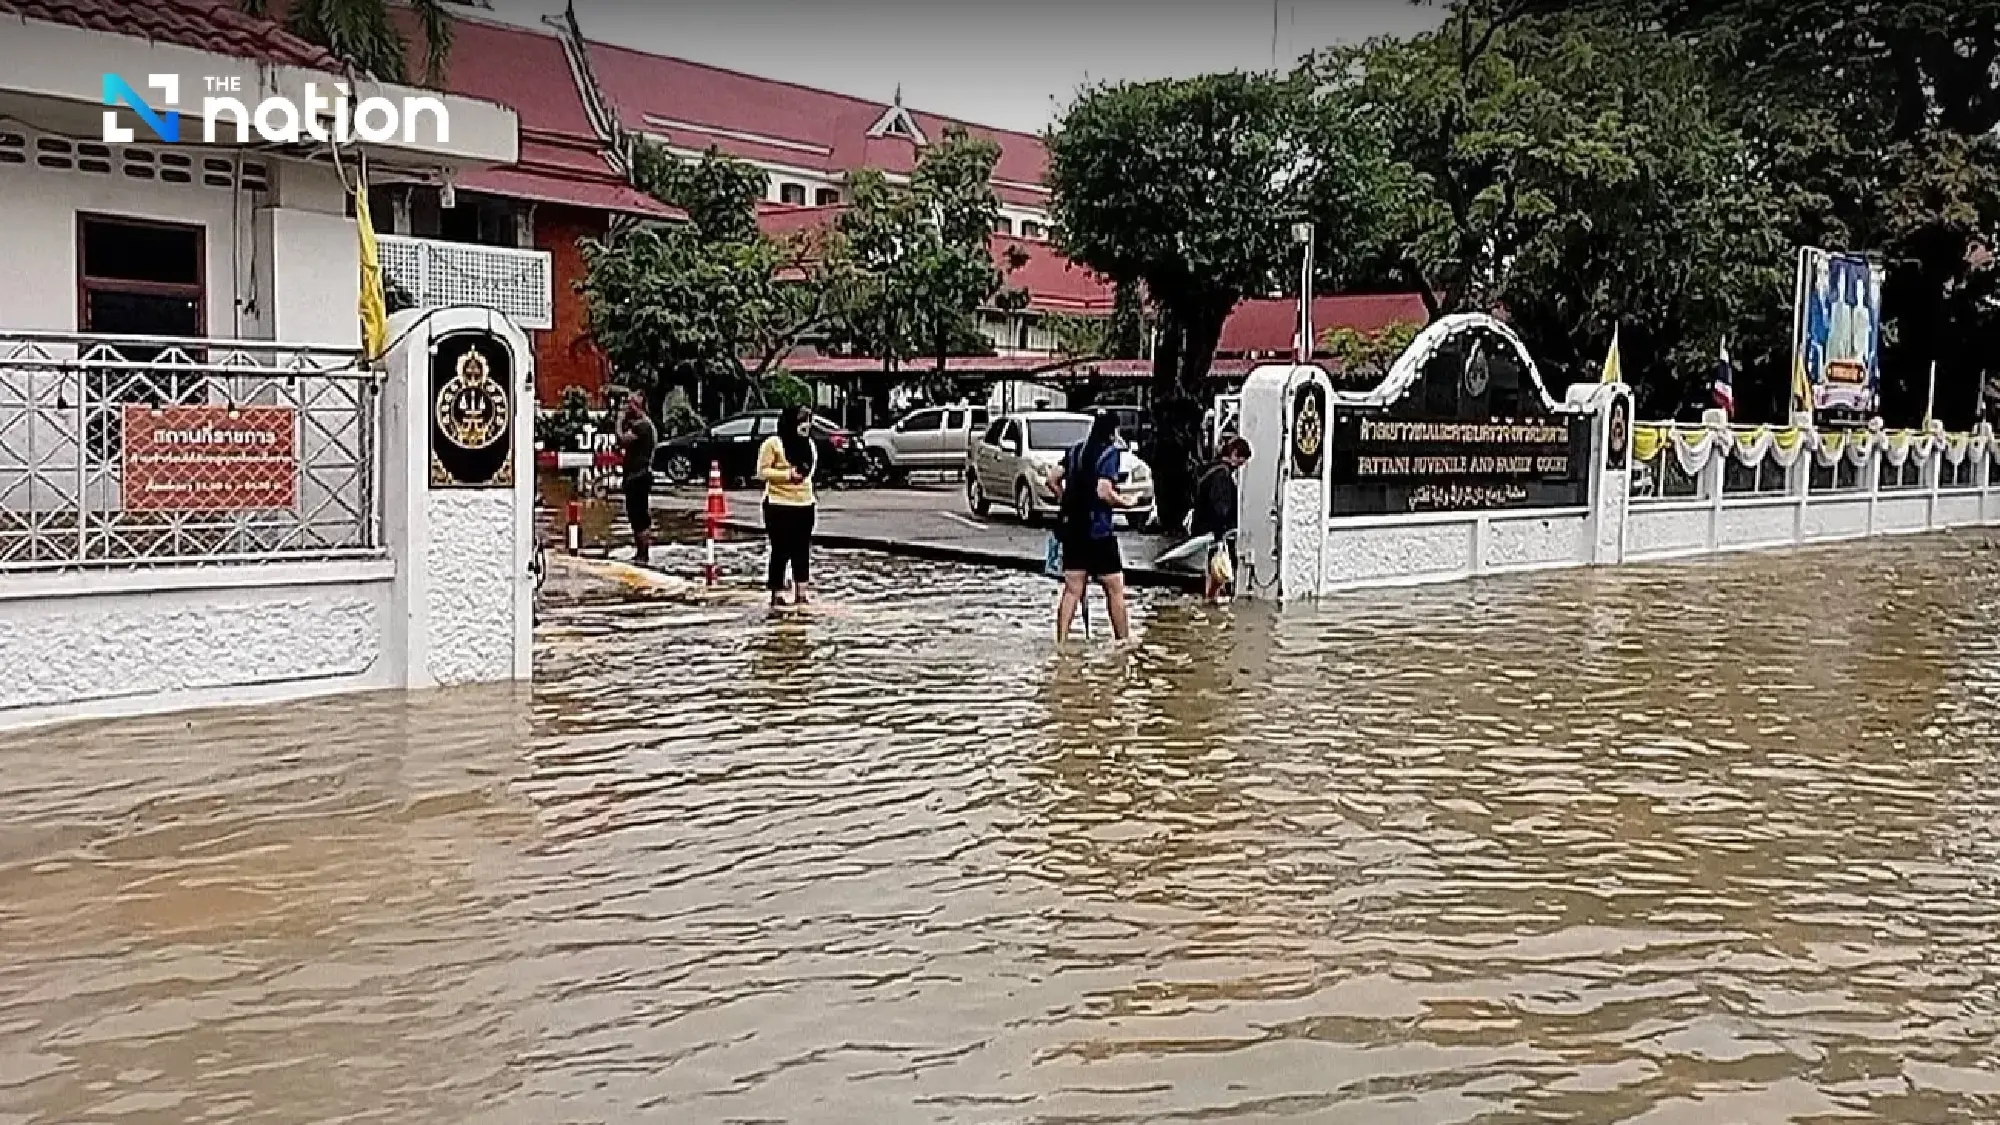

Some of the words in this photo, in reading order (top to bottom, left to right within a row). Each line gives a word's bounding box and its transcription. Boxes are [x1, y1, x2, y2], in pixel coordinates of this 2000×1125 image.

[154, 420, 276, 444] สถานที่ราชการ
[1357, 456, 1410, 474] PATTANI
[1412, 456, 1467, 474] JUVENILE
[1470, 456, 1495, 473] AND
